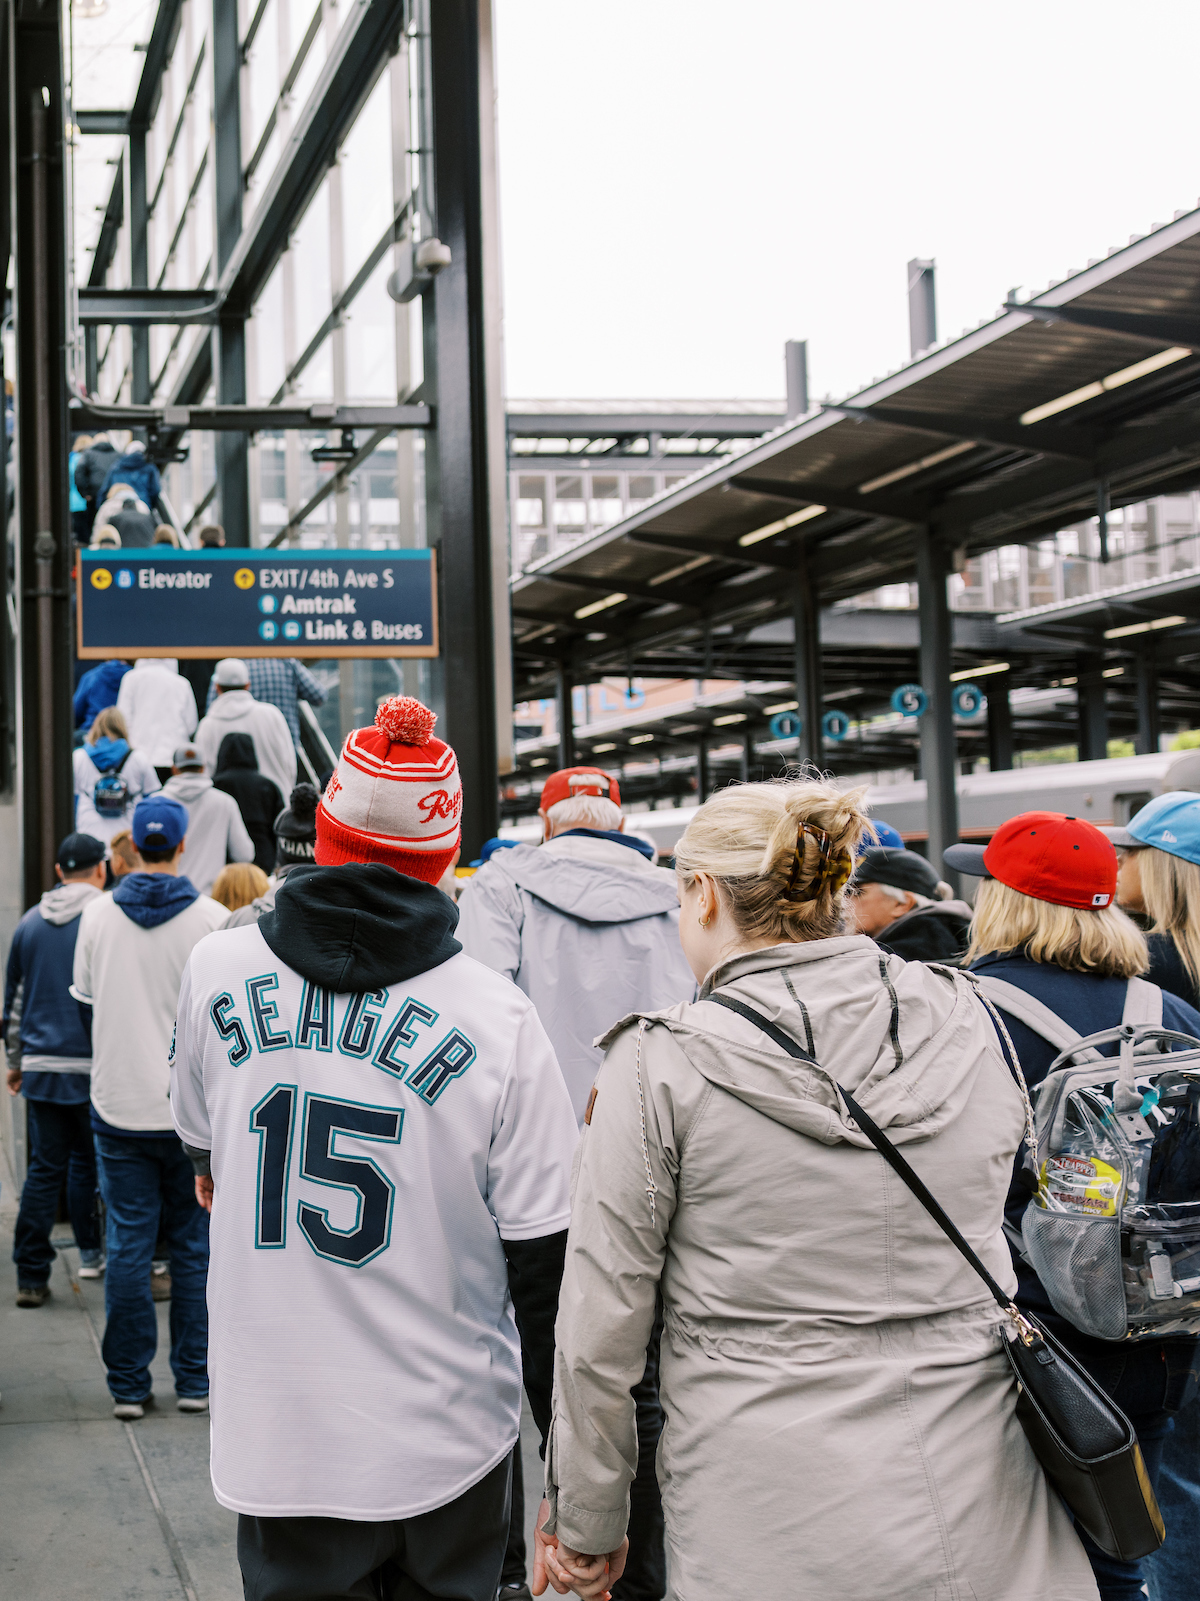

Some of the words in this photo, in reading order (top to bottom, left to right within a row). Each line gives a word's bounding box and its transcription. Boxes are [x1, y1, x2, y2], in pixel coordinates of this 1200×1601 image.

[138, 567, 213, 589] Elevator
[343, 568, 379, 589] Ave
[382, 568, 395, 589] S
[280, 593, 357, 615] Amtrak
[305, 619, 349, 640] Link
[352, 619, 367, 640] &
[370, 619, 423, 640] Buses
[903, 692, 919, 712] 5
[959, 692, 975, 712] 6
[210, 972, 477, 1106] SEAGER
[249, 1082, 406, 1269] 15
